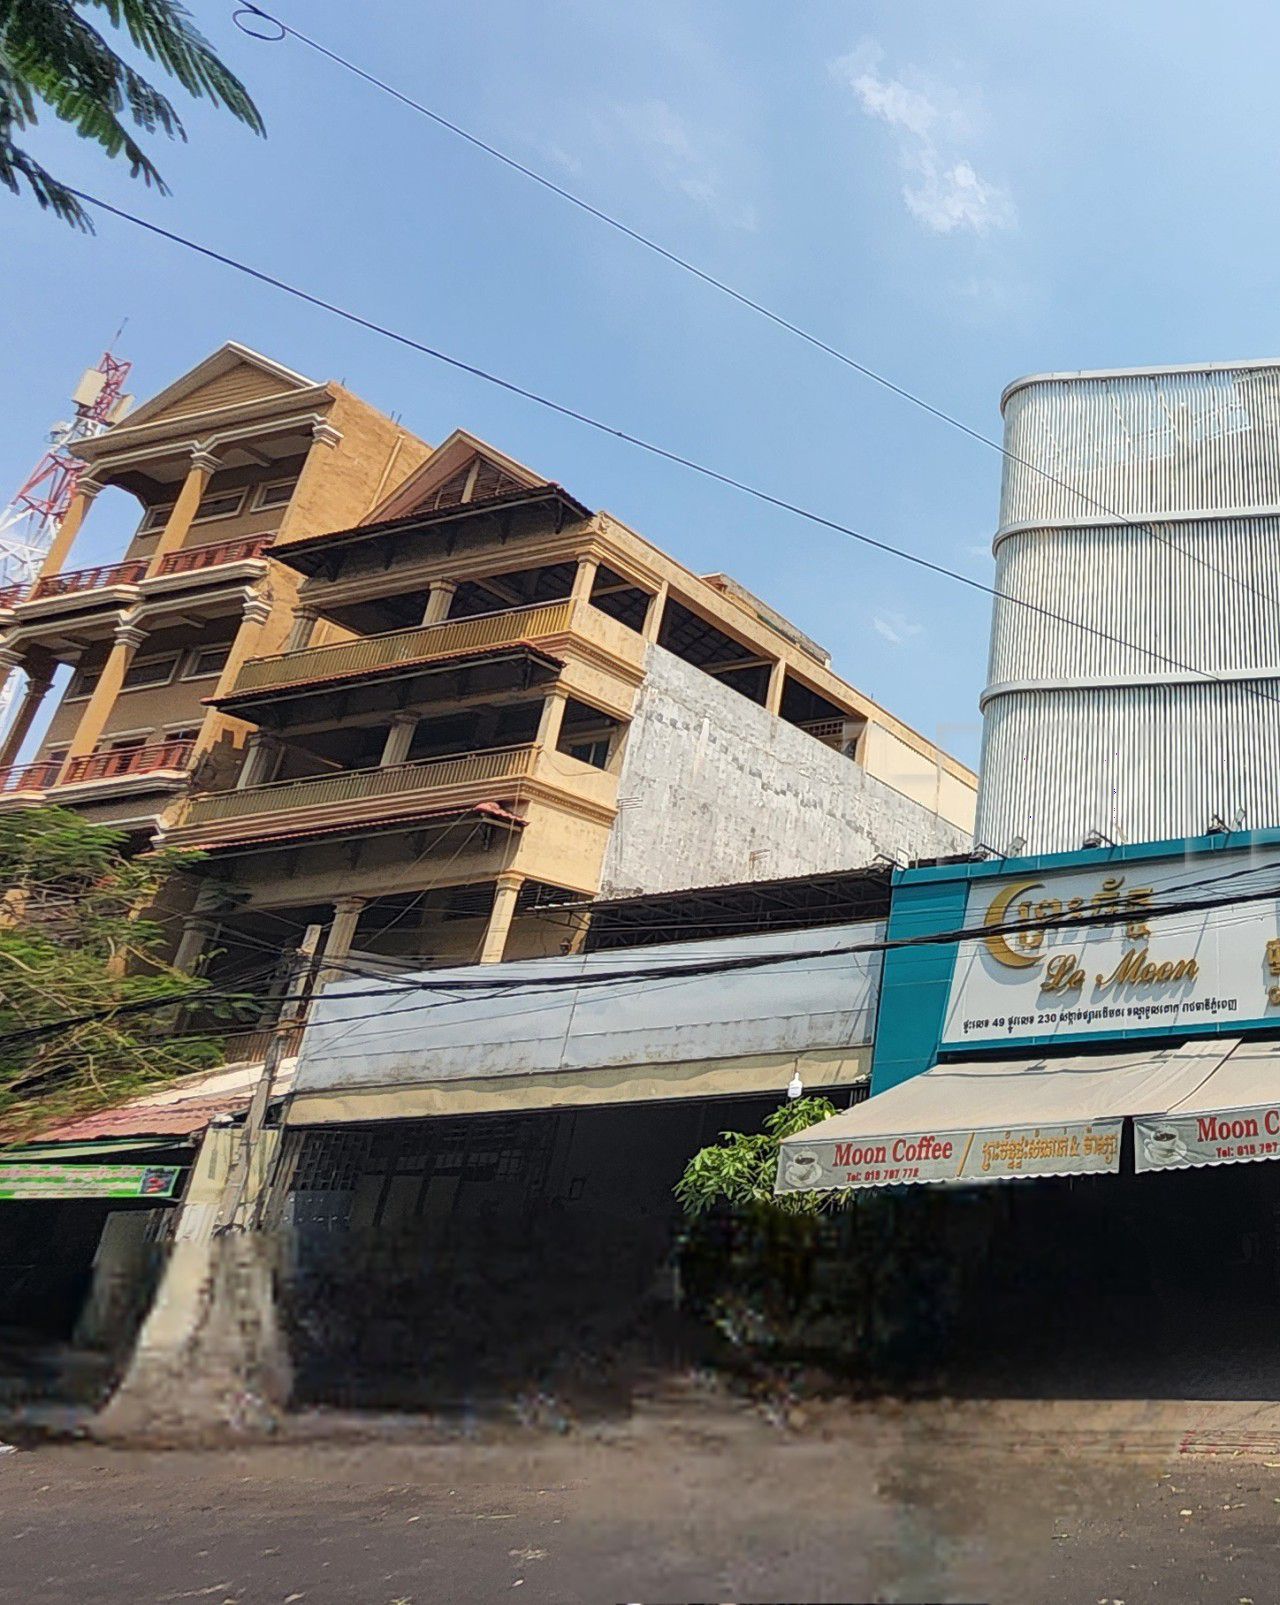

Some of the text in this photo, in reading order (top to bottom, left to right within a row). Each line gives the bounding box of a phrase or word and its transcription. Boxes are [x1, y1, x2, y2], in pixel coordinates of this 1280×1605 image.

[1040, 947, 1200, 993] Le Moon
[992, 1017, 1006, 1027] 49
[1037, 1013, 1057, 1024] 230
[1197, 1116, 1259, 1143] Moon
[832, 1136, 953, 1167] Moon Coffee
[1216, 1146, 1234, 1158] Tel:
[847, 1172, 862, 1182] Tel:
